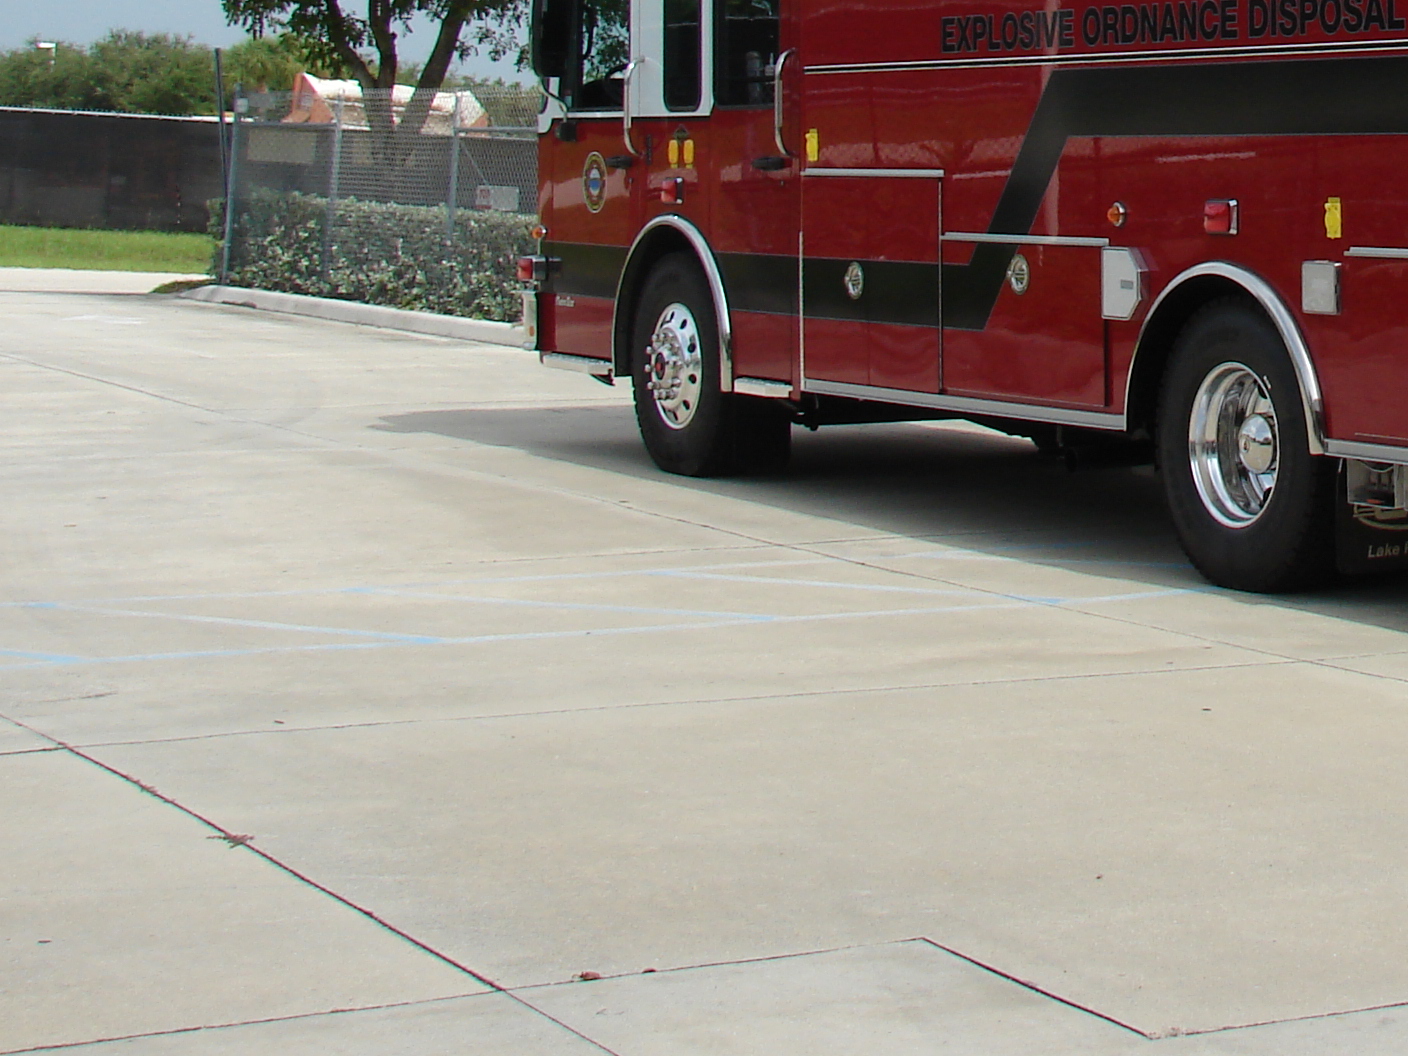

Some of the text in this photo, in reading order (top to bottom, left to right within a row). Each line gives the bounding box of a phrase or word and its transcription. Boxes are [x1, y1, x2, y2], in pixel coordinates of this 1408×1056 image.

[940, 8, 1075, 53] EXPLOSIVE
[1082, 0, 1238, 46] ORDNANCE
[1367, 543, 1401, 559] Lake
